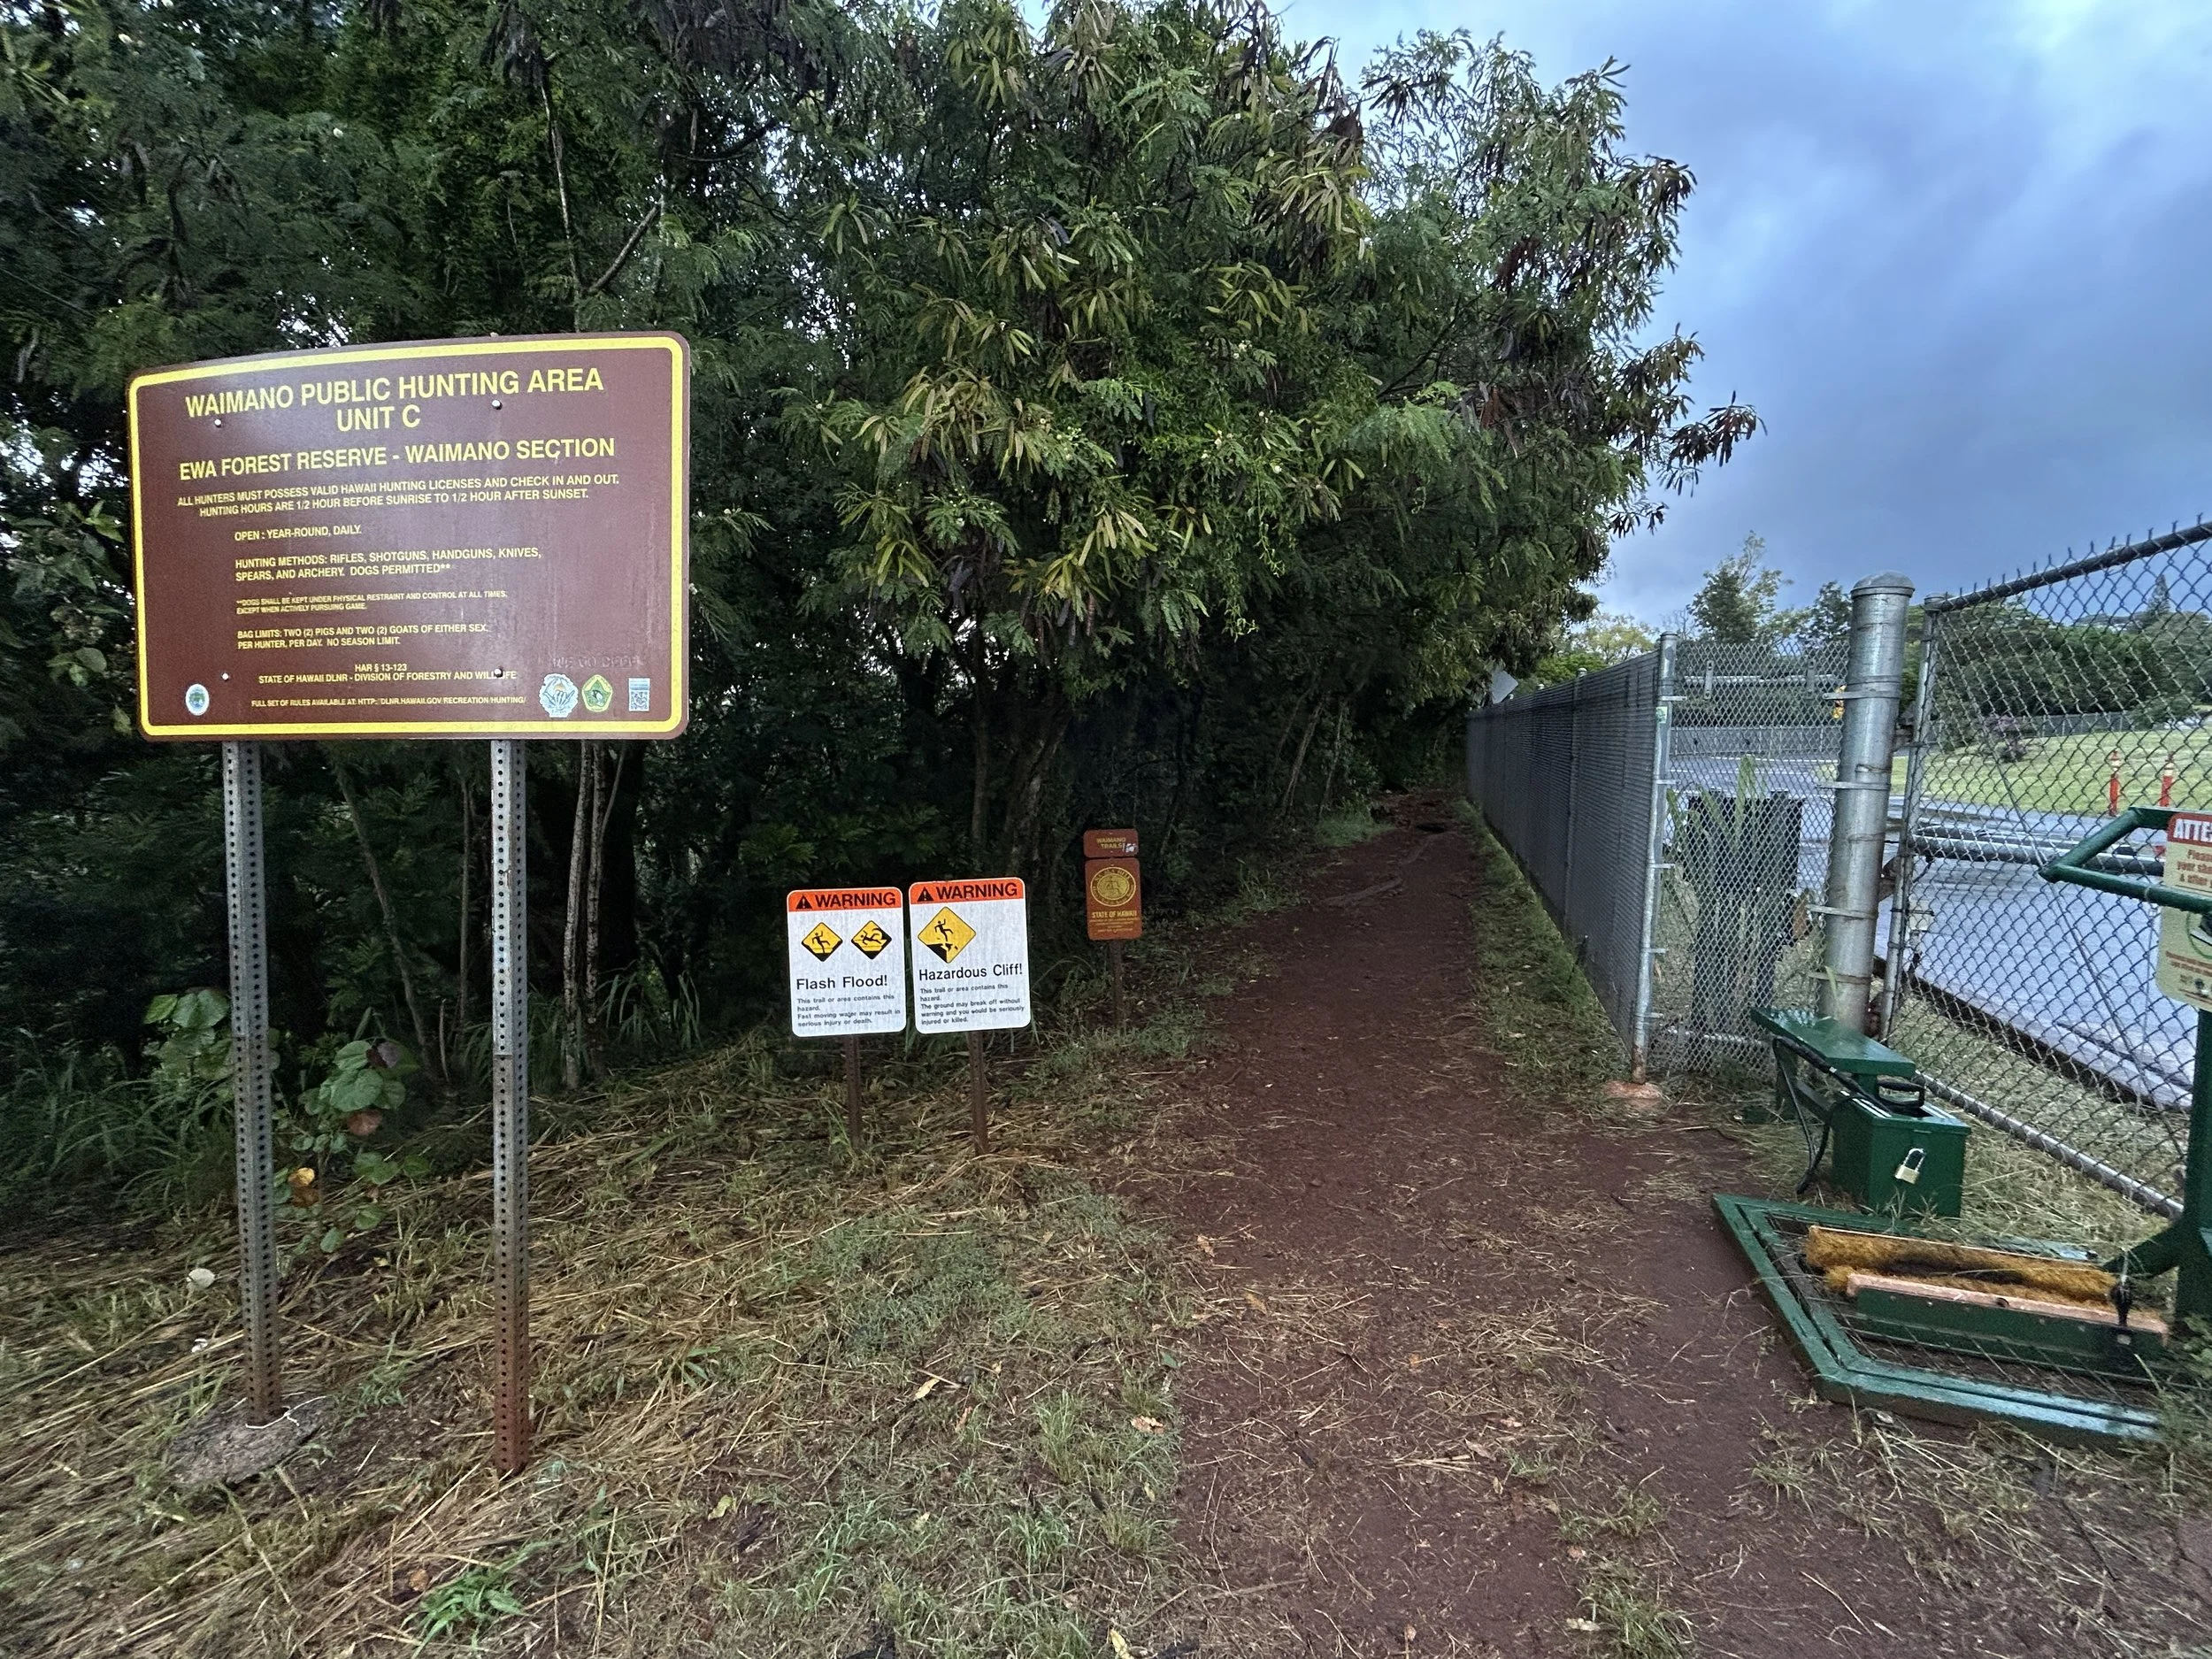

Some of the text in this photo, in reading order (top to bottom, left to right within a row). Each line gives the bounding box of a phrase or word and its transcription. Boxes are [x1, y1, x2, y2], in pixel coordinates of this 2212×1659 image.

[185, 368, 603, 418] WAIMANO PUBLIC HUNTING AREA
[336, 404, 420, 432] UNIT C
[180, 438, 615, 480] EWA FOREST RESERVE WAIMANO SECTION
[177, 474, 618, 506] ALL HUNTERS MUST POSSESS VALID HAWAII HUNTING LICENSES AND CHECK IN AND OUT.
[200, 488, 588, 517] HUNTING HOURS ARE 1/2 HOUR BEFORE SUNRISE TO 1/2 HOUR AFTER SUNSET.
[234, 525, 362, 541] OPEN YEAR-ROUND, DAILY.
[235, 547, 541, 569] HUNTING METHODS: RIFLES, SHOTGUNS, HANDGUNS, KNIVES,
[235, 571, 274, 581] SPEARS,
[276, 569, 296, 580] AND
[297, 567, 345, 579] ARCHERY.
[349, 565, 380, 576] DOGS
[303, 628, 313, 638] (2)
[315, 627, 334, 636] PIGS
[336, 626, 353, 635] AND
[377, 626, 388, 635] (2)
[389, 625, 419, 634] GOATS
[434, 624, 466, 633] EITHER
[289, 639, 304, 648] PER
[341, 637, 375, 646] SEASON
[355, 664, 373, 672] HAR
[380, 663, 407, 672] 13-123
[258, 675, 281, 684] STATE
[326, 673, 348, 682] DLNR
[355, 672, 390, 681] DIVISION
[406, 672, 452, 680] FORESTRY
[454, 671, 472, 680] AND
[475, 671, 517, 680] WILIFE
[936, 882, 1018, 900] WARNING
[815, 892, 895, 908] WARNING
[919, 964, 1023, 981] Hazardous Cliff!
[796, 975, 887, 990] Flash Flood!
